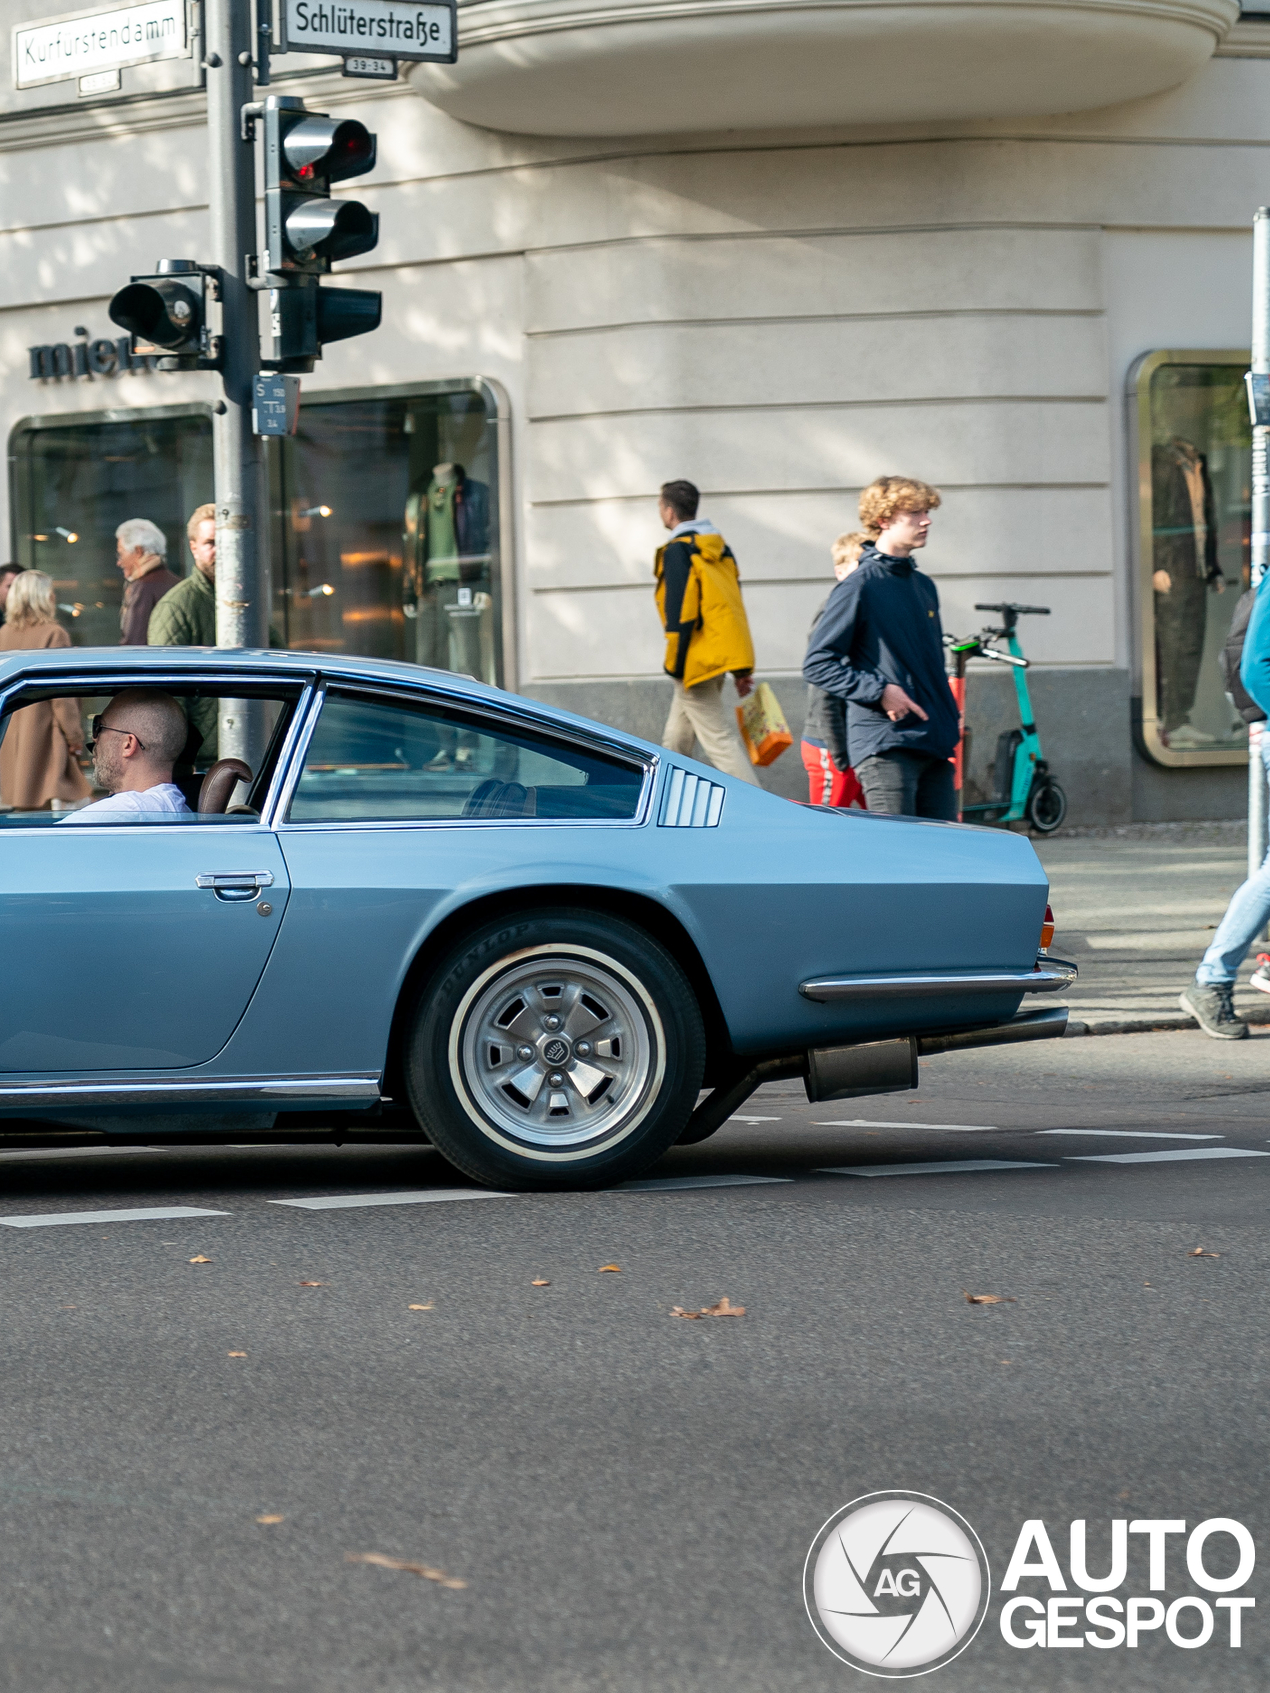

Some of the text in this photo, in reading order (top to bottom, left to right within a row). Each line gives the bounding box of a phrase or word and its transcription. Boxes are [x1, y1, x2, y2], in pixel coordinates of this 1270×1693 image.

[24, 16, 176, 65] Kurfürstendamm
[296, 2, 440, 46] Schlüterstraße
[353, 59, 387, 71] 39-34
[29, 325, 158, 379] mien
[441, 924, 529, 996] DUNLOP
